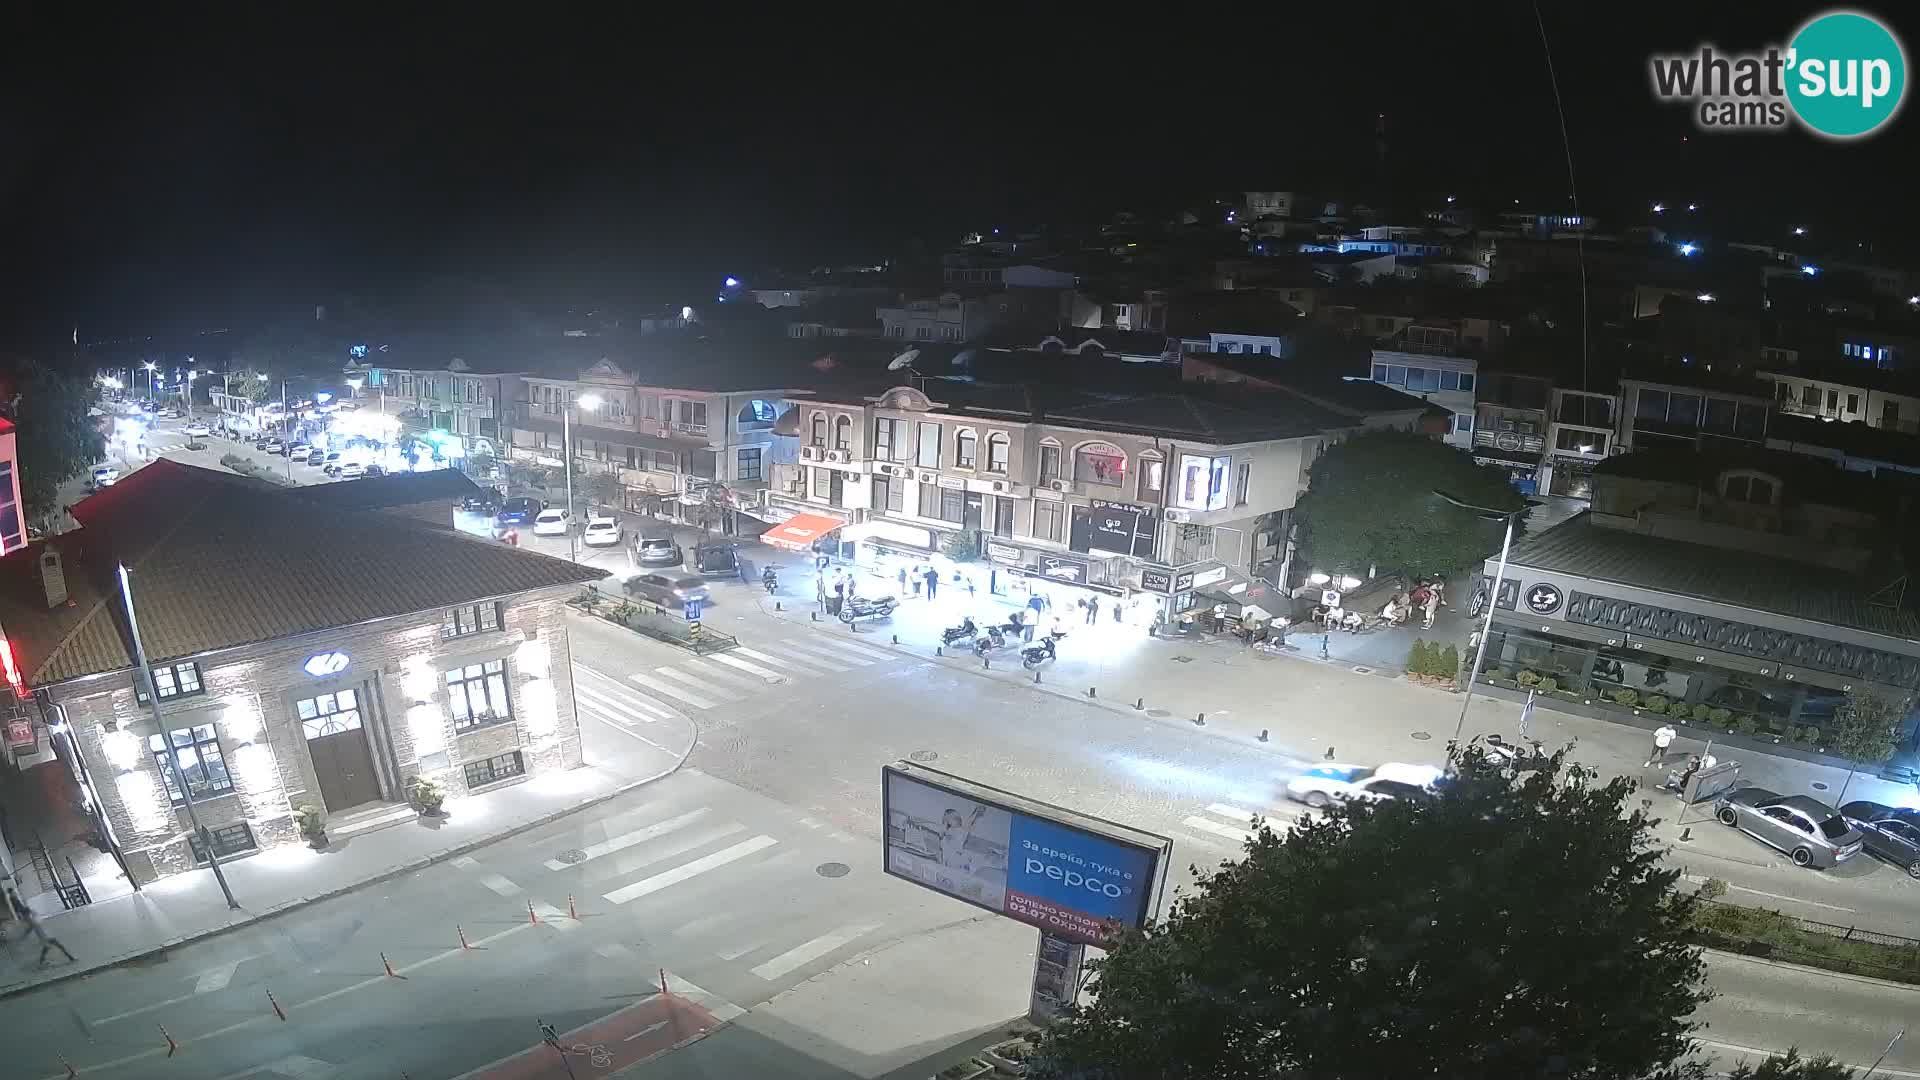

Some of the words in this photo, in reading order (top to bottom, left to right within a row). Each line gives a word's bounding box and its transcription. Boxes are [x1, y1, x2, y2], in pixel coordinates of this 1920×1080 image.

[1022, 840, 1039, 851] За
[1090, 862, 1120, 876] тука
[1025, 858, 1121, 898] pepco
[1009, 902, 1047, 920] 02.07
